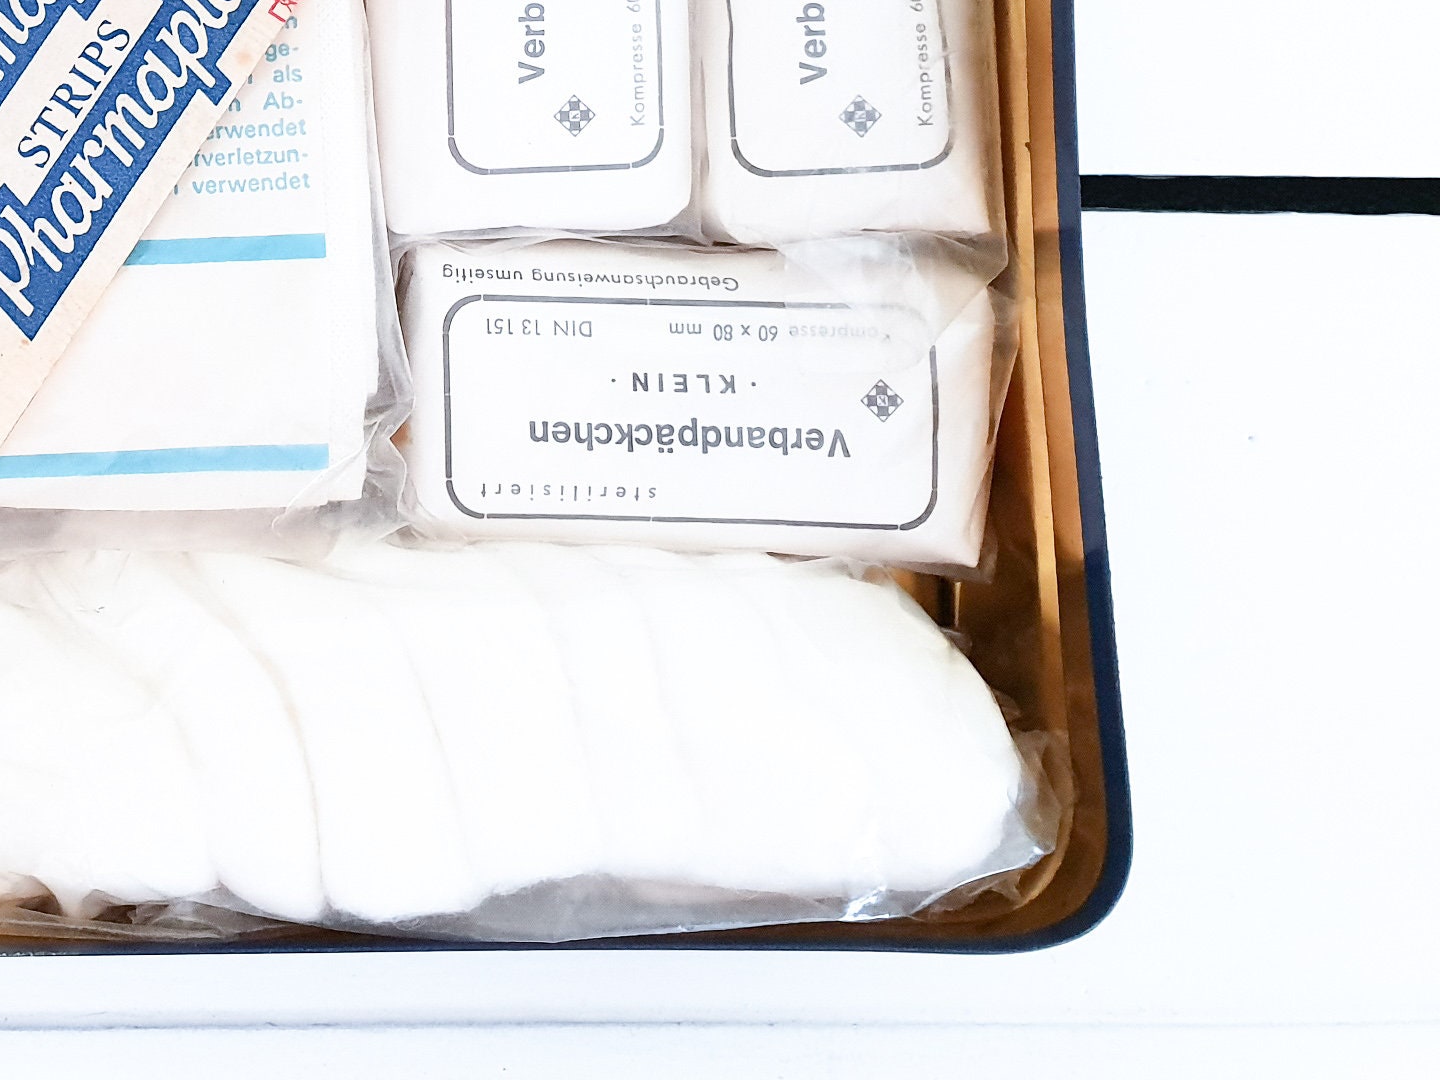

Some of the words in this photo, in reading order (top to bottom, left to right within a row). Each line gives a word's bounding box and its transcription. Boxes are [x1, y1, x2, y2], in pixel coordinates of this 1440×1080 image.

[273, 65, 303, 84] als
[630, 22, 647, 127] Kompresse
[916, 22, 934, 127] Kompresse
[18, 17, 130, 170] STRIPS
[263, 91, 304, 111] Ab-
[206, 118, 307, 141] rwendet
[192, 172, 312, 195] verwendet
[442, 263, 523, 284] umseitig
[532, 268, 739, 292] Gebrauchsanweisung
[486, 318, 513, 335] 151
[522, 319, 541, 336] 13
[553, 319, 593, 338] DIN
[669, 322, 702, 335] mm
[713, 323, 733, 341] 80
[758, 324, 778, 342] 60
[631, 372, 736, 395] KLEIN
[529, 417, 851, 458] Verbandpäckchen
[480, 482, 657, 502] sterilisiert
